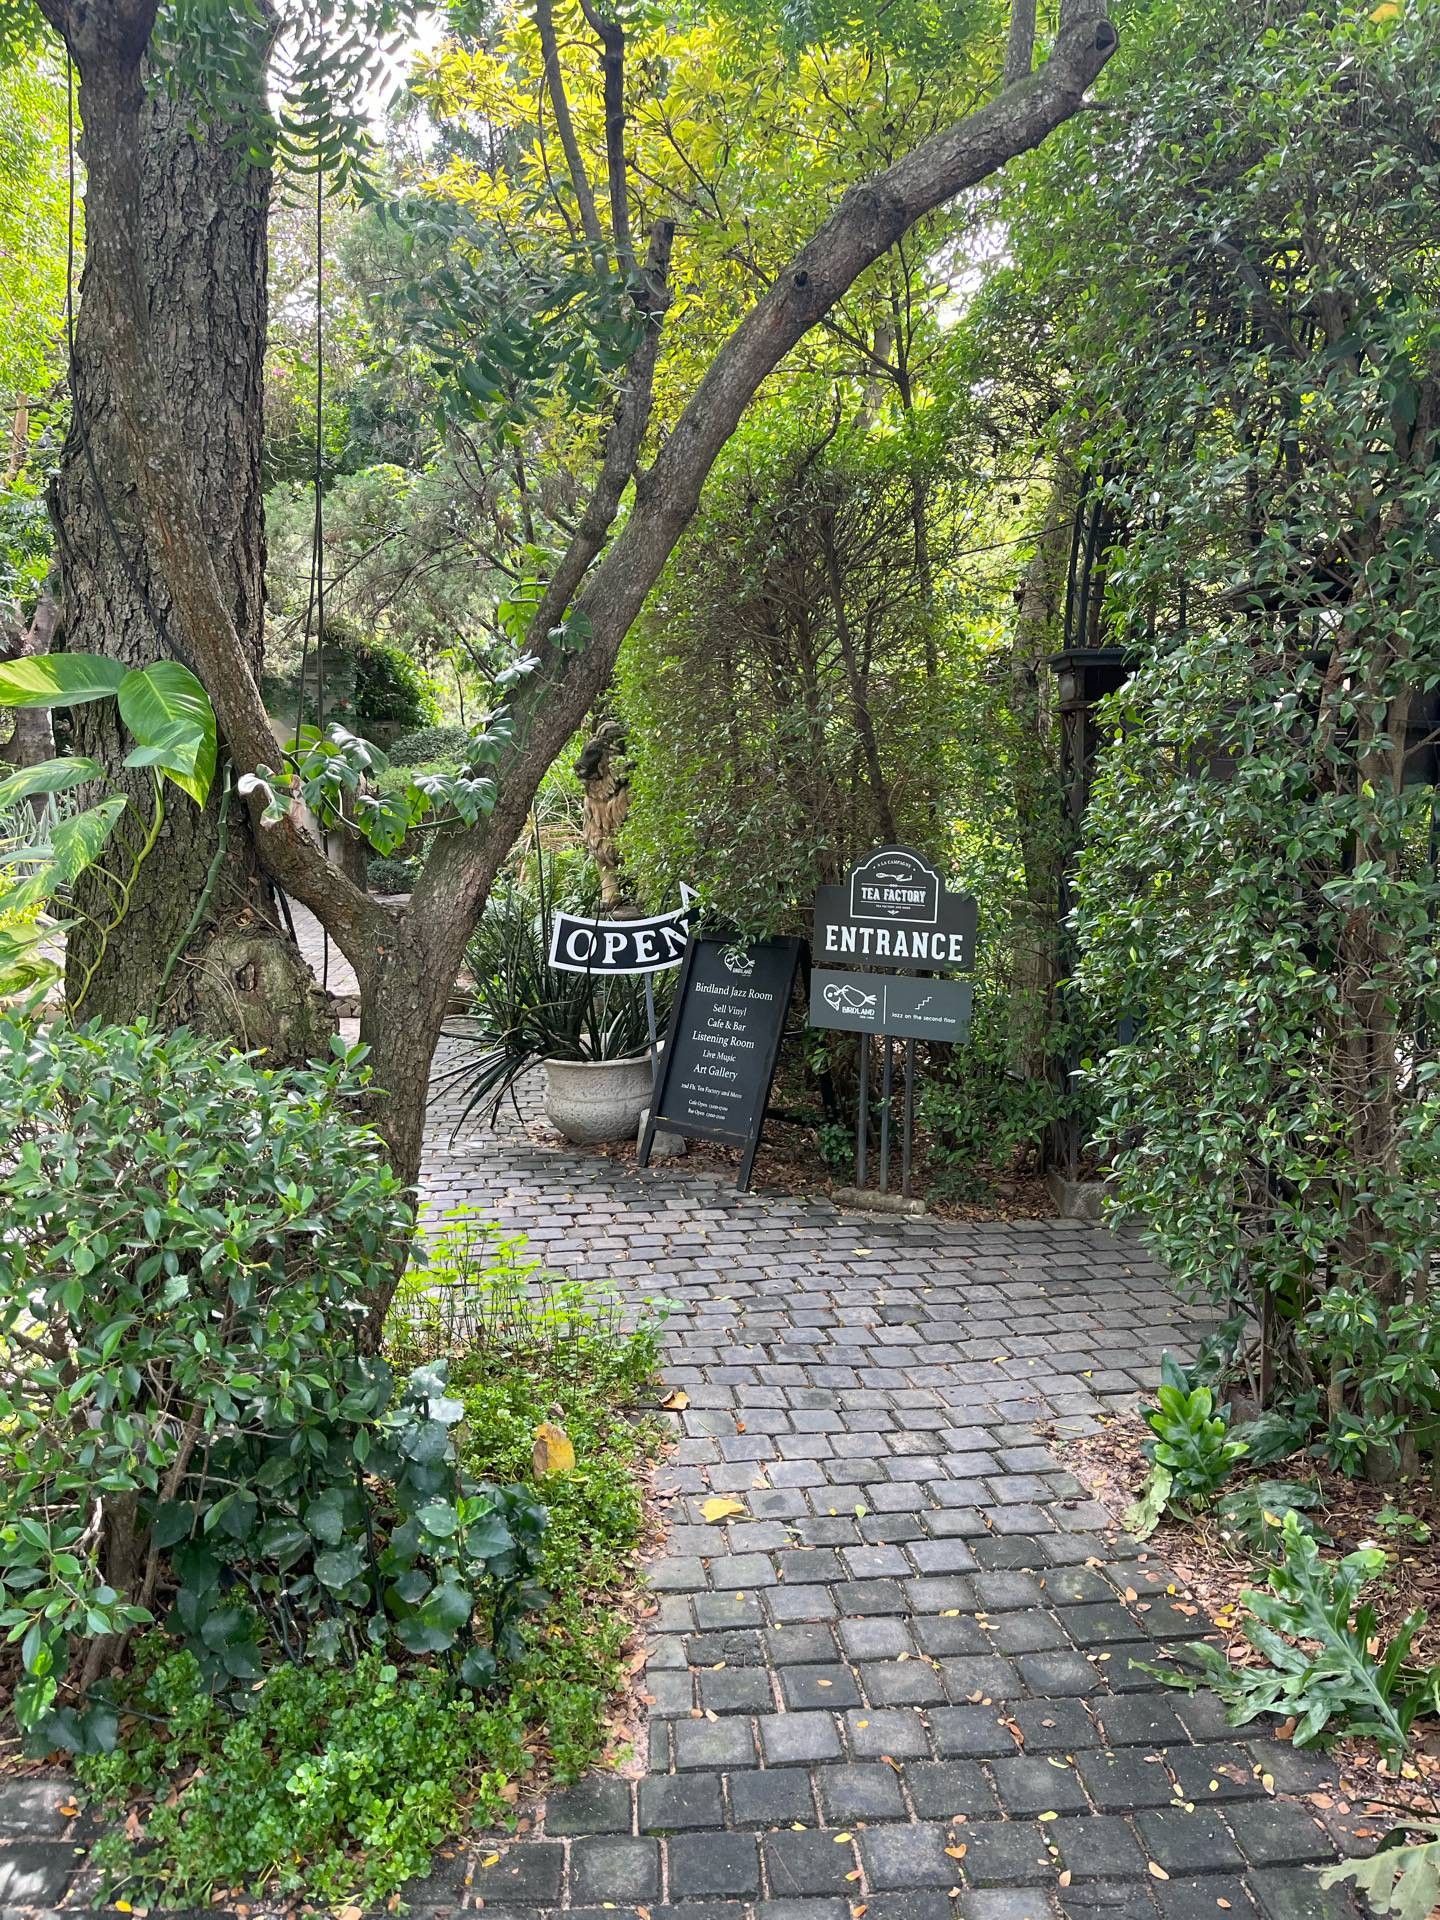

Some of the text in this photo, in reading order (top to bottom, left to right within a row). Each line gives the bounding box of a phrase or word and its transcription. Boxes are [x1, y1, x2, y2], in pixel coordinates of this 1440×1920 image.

[861, 887, 926, 903] TEA FACTORY
[566, 919, 689, 964] OPEN
[825, 925, 964, 962] ENTRANCE
[695, 982, 773, 1000] Birdland Jazz Room
[712, 1003, 747, 1017] Sell Vinyl
[841, 1006, 875, 1016] BIRDLAND
[707, 1018, 746, 1031] Cafe & Bar
[692, 1030, 755, 1048] Listening Room
[702, 1049, 736, 1062] Live Music
[693, 1064, 738, 1082] Art Gallery
[705, 1086, 720, 1096] Factory
